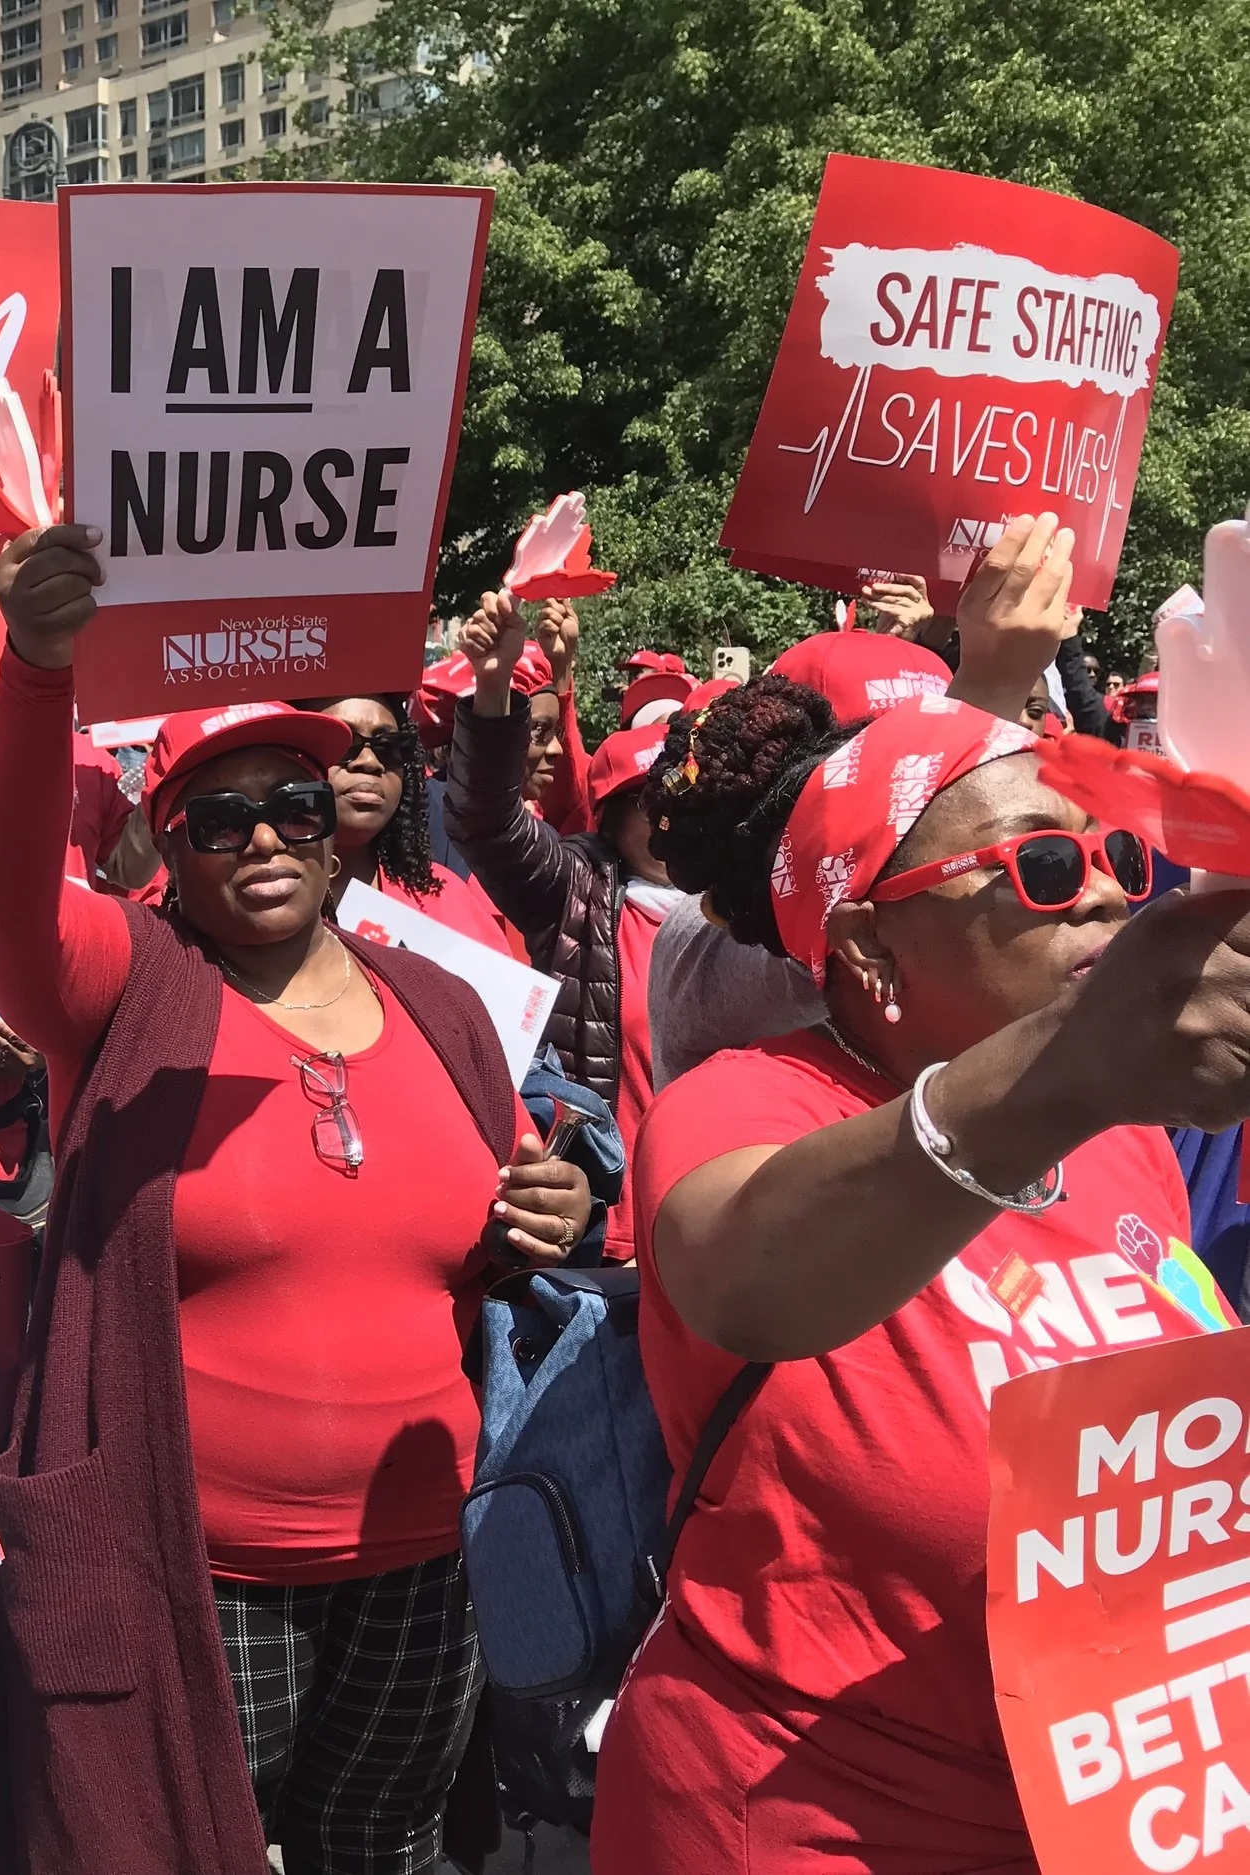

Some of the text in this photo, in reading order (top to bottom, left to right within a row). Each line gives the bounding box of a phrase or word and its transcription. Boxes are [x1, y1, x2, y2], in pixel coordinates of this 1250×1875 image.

[111, 267, 411, 394] I AM A
[870, 272, 1142, 379] SAFE STAFFING
[881, 392, 1107, 504] SAVES LIVES
[110, 447, 410, 557] NURSE
[163, 627, 328, 670] NURSES
[164, 658, 327, 684] ASSOCIATION
[220, 615, 328, 631] New York State
[1077, 1397, 1250, 1497] MO
[1129, 1762, 1250, 1873] CA
